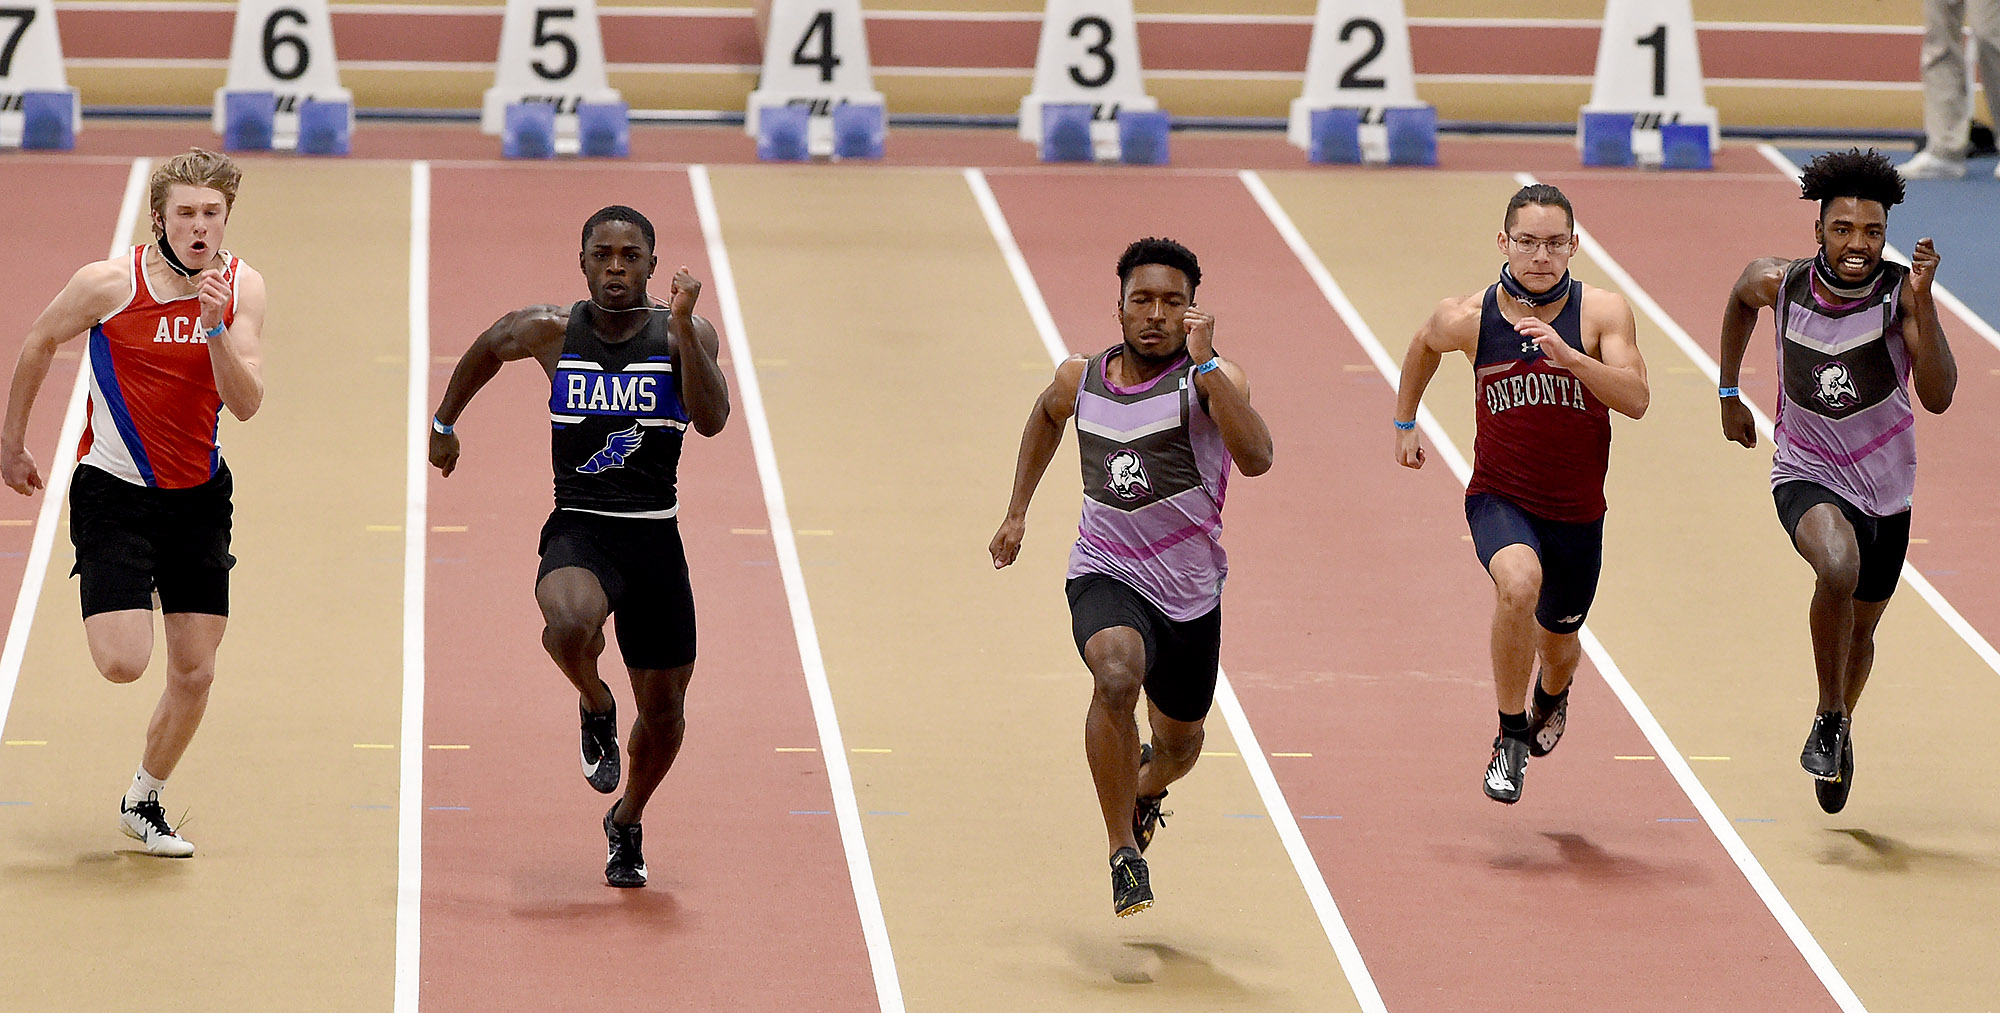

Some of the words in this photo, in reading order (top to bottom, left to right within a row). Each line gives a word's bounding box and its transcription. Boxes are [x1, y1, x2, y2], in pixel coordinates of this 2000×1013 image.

[0, 8, 35, 77] 7
[262, 8, 310, 81] 6
[532, 9, 578, 80] 5
[792, 12, 840, 82] 4
[1069, 16, 1115, 88] 3
[1339, 18, 1385, 89] 2
[1637, 26, 1666, 96] 1
[566, 374, 657, 412] RAMS
[1486, 372, 1586, 415] ONEONTA
